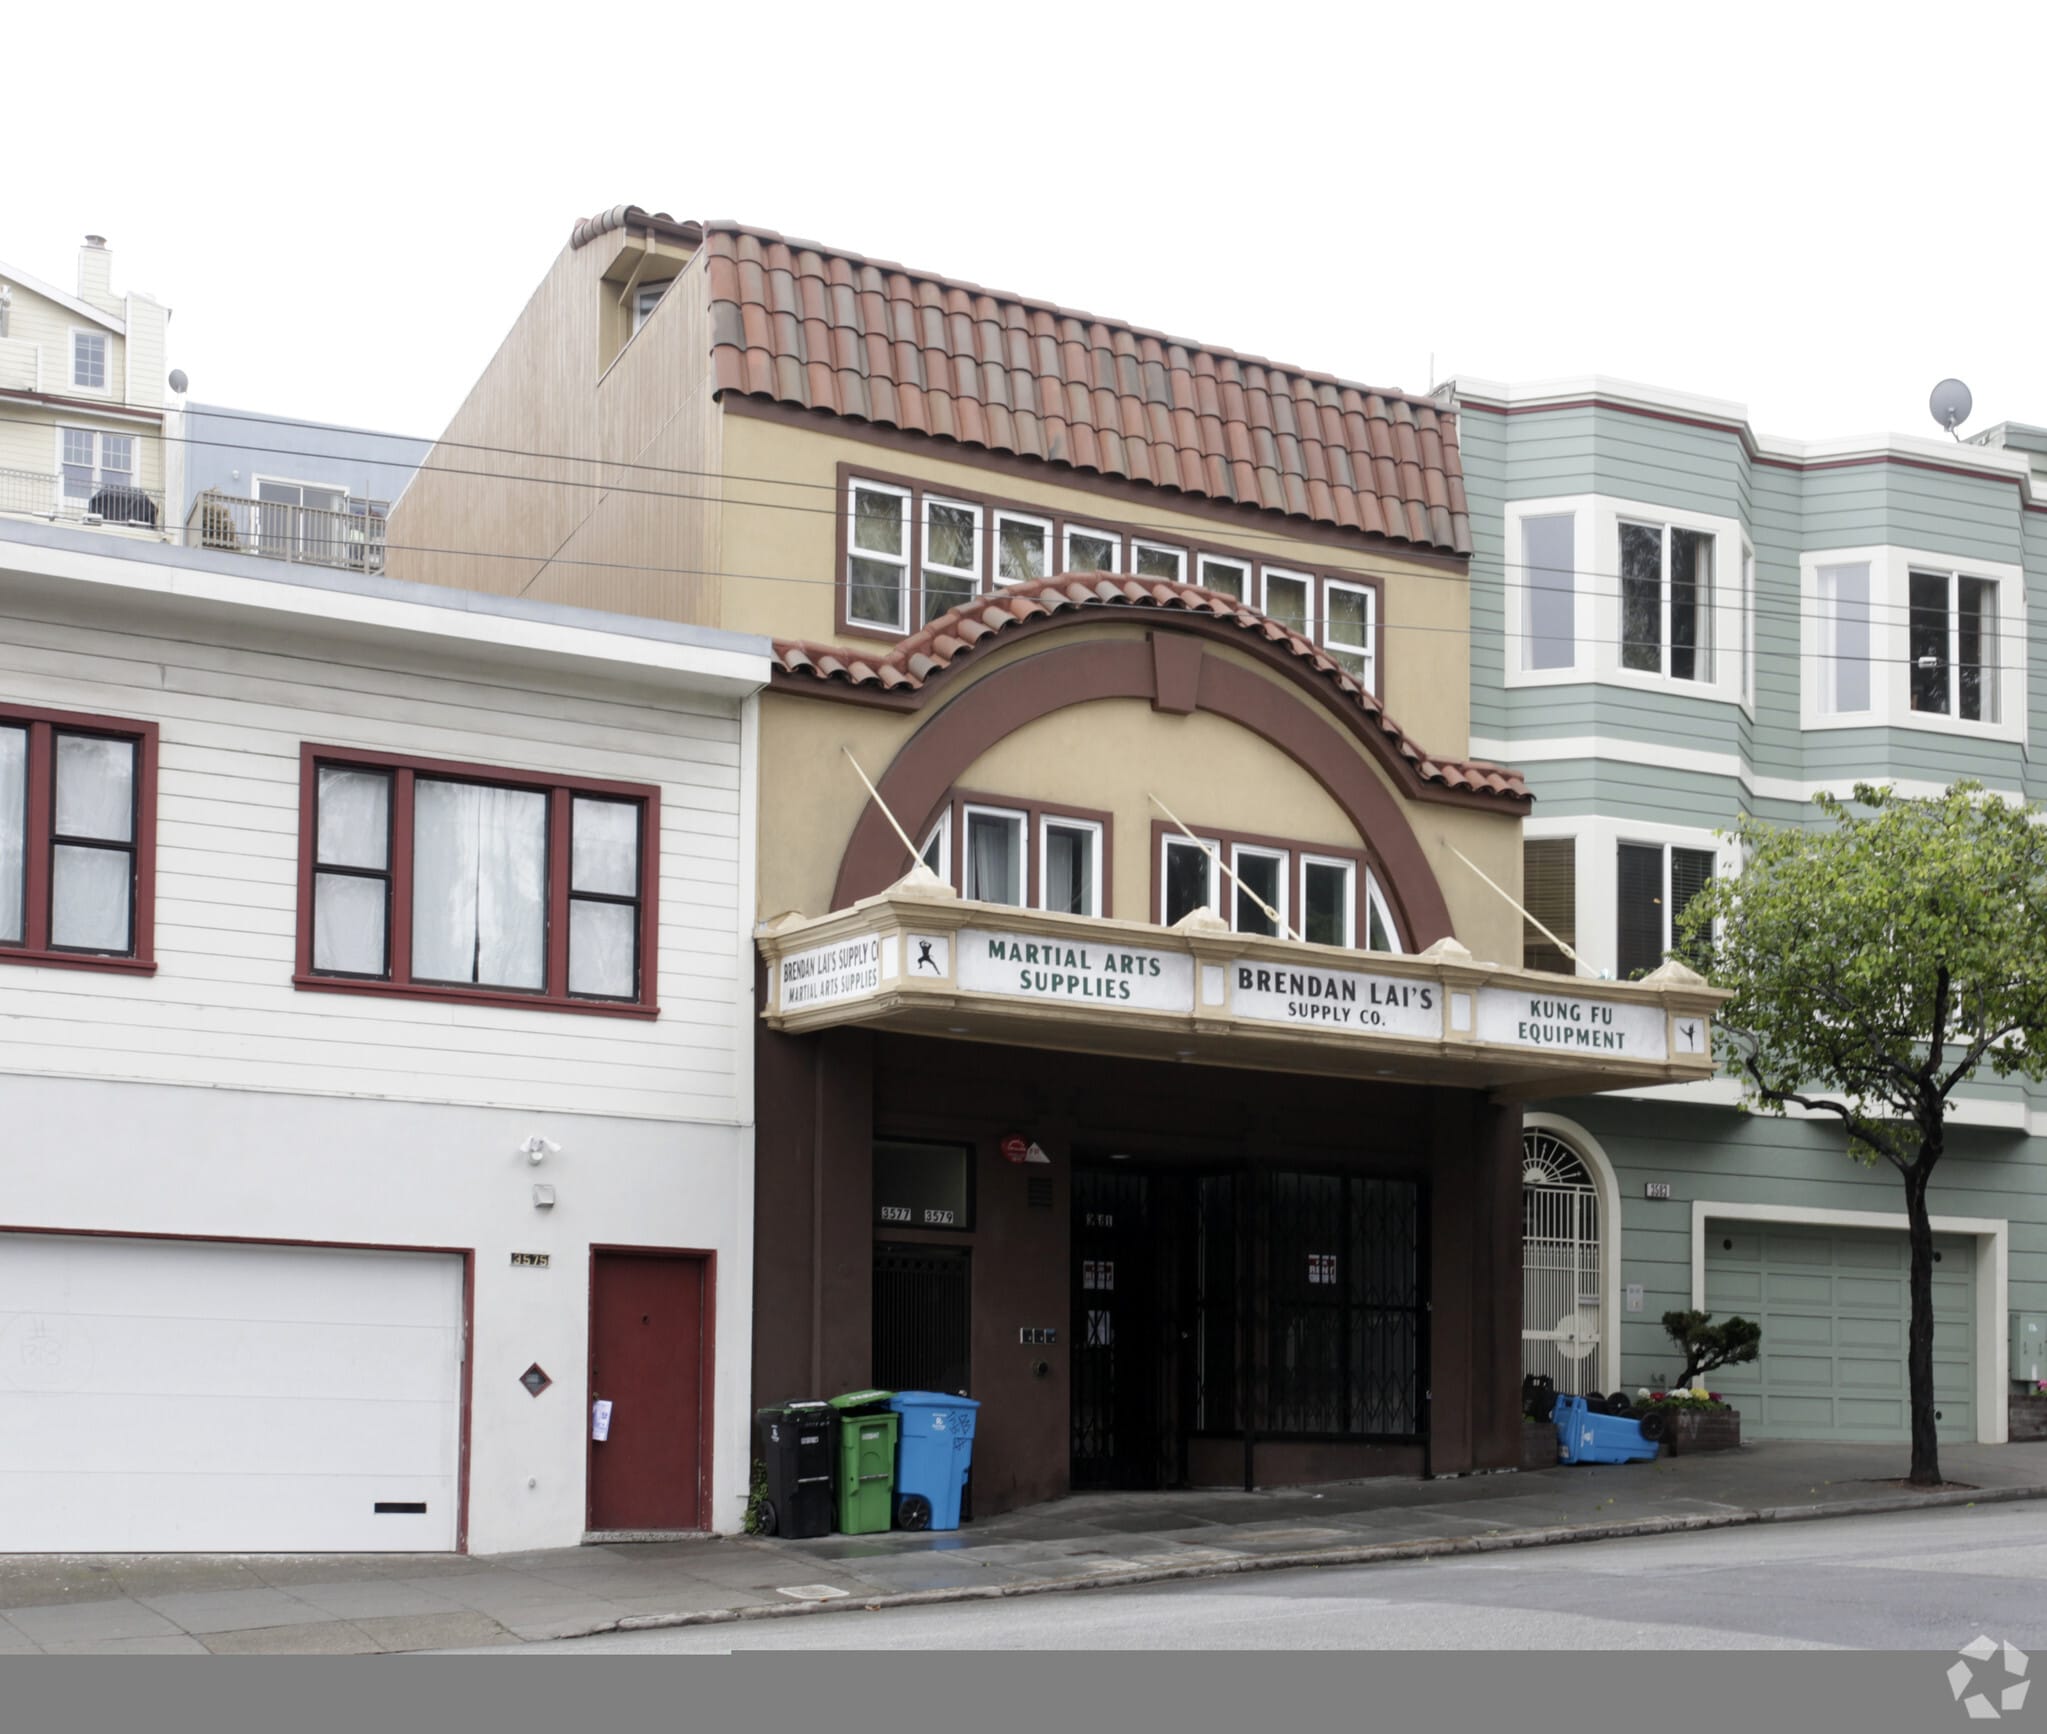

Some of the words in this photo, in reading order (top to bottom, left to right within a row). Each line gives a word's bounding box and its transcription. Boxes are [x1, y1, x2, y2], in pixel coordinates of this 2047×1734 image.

[784, 956, 815, 982] BRENDAN
[817, 950, 836, 974] LAI'S
[839, 943, 868, 970] SUPPLY
[988, 939, 1092, 969] MARTIAL
[1104, 953, 1161, 977] ARTS
[788, 982, 818, 1003] MARTIAL
[820, 977, 838, 997] ARTS
[841, 968, 877, 993] SUPPLIES
[1020, 969, 1131, 1000] SUPPLIES
[1238, 967, 1356, 1002] BRENDAN
[1370, 982, 1433, 1010] LAI'S
[1288, 1001, 1351, 1023] SUPPLY
[1359, 1010, 1386, 1026] CO.
[1530, 1000, 1581, 1022] KUNG
[1590, 1006, 1613, 1026] FU
[1518, 1022, 1625, 1050] EQUIPMENT
[882, 1207, 911, 1221] 3577
[925, 1210, 953, 1224] 3579
[513, 1253, 548, 1266] 3575
